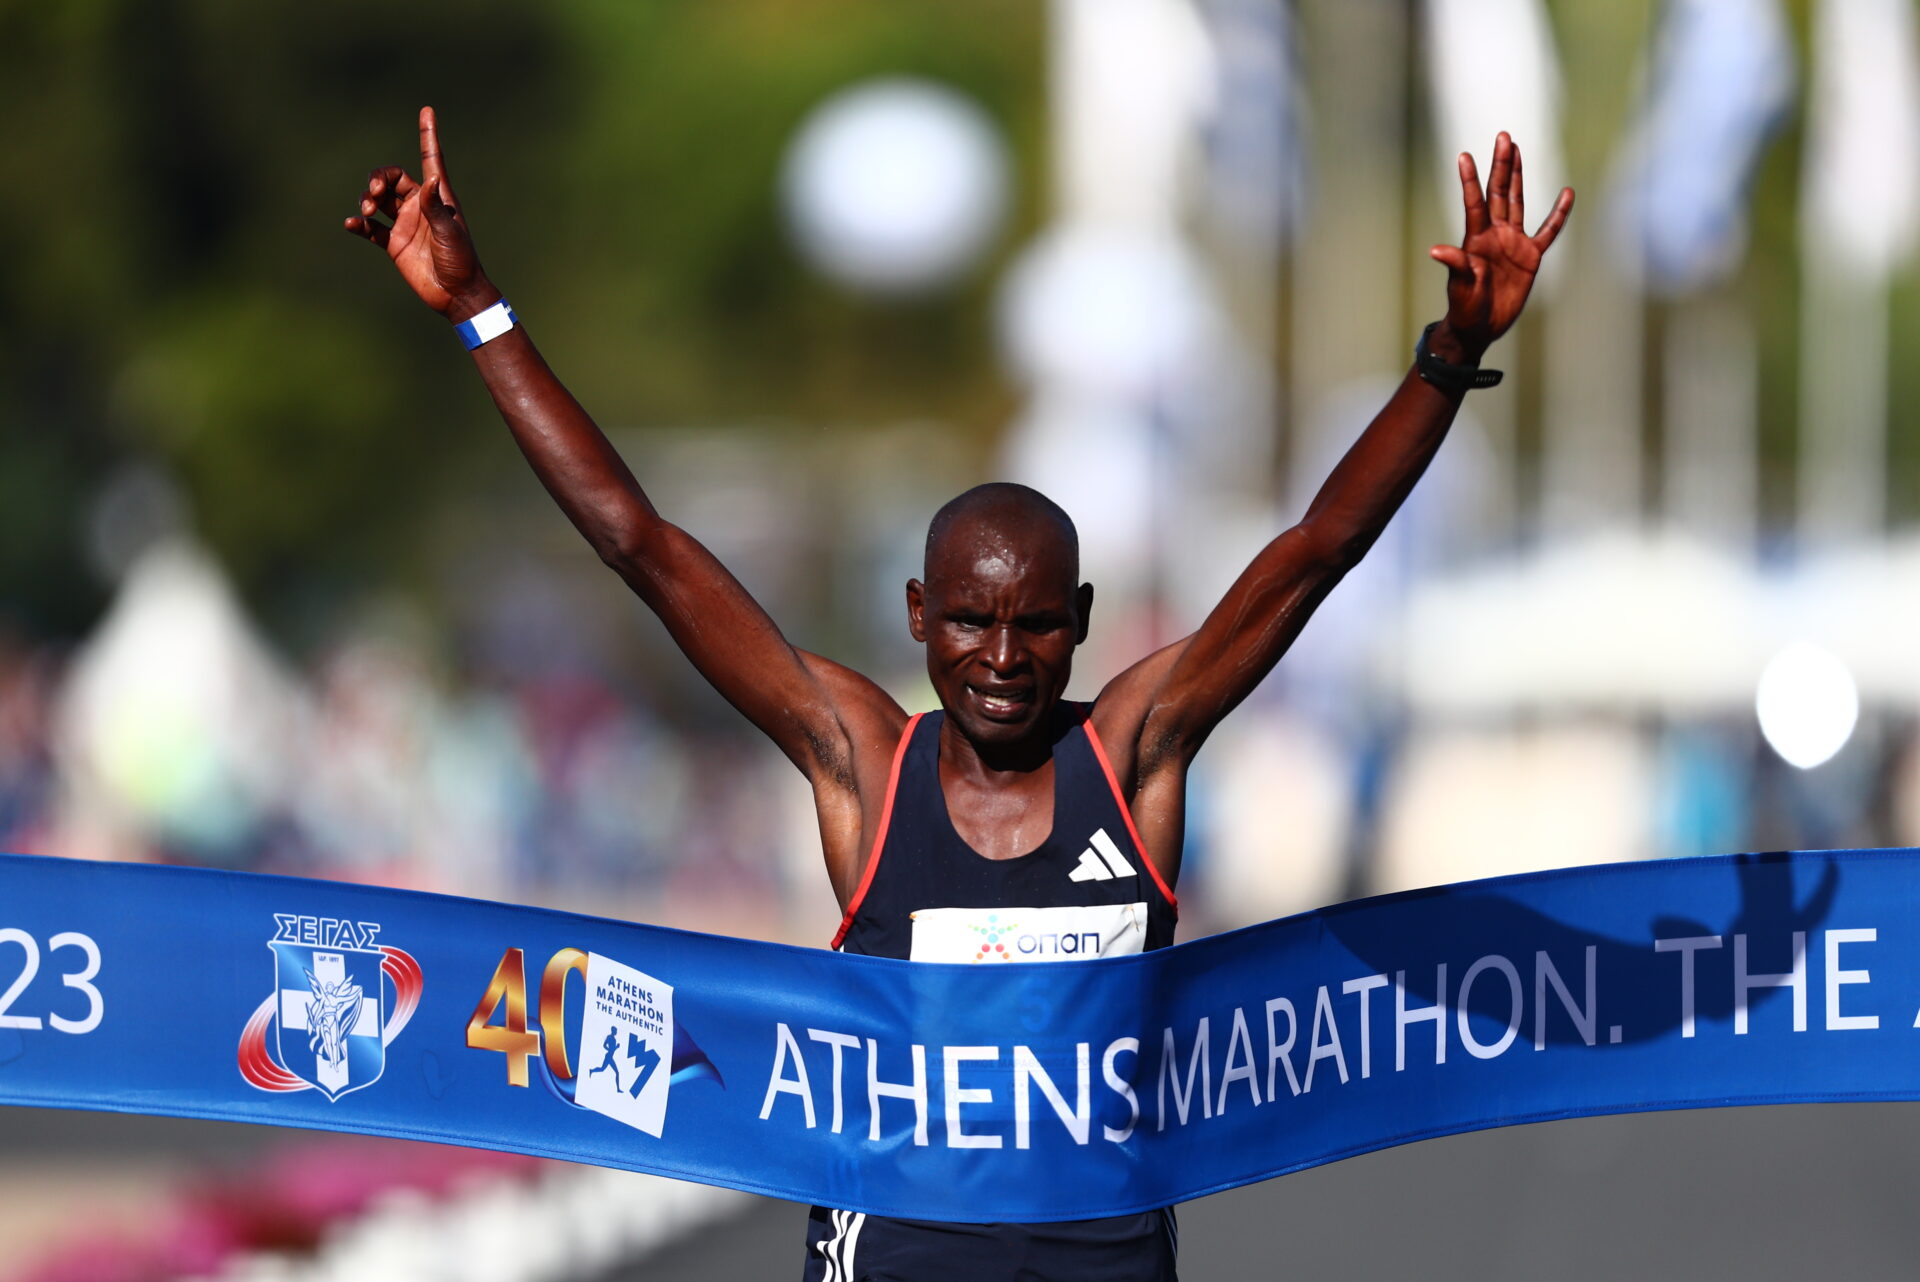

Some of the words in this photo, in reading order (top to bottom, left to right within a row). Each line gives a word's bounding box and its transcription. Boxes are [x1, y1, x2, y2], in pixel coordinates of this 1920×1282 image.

[273, 912, 381, 949] ΣΕΓΑΣ
[0, 928, 104, 1035] 23
[608, 975, 653, 1004] ATHENS
[596, 986, 664, 1024] MARATHON
[596, 1001, 613, 1015] THE
[615, 1009, 664, 1036] AUTHENTIC
[758, 1022, 1140, 1150] ATHENS
[1156, 945, 1622, 1132] MARATHON.
[1654, 928, 1880, 1039] THE
